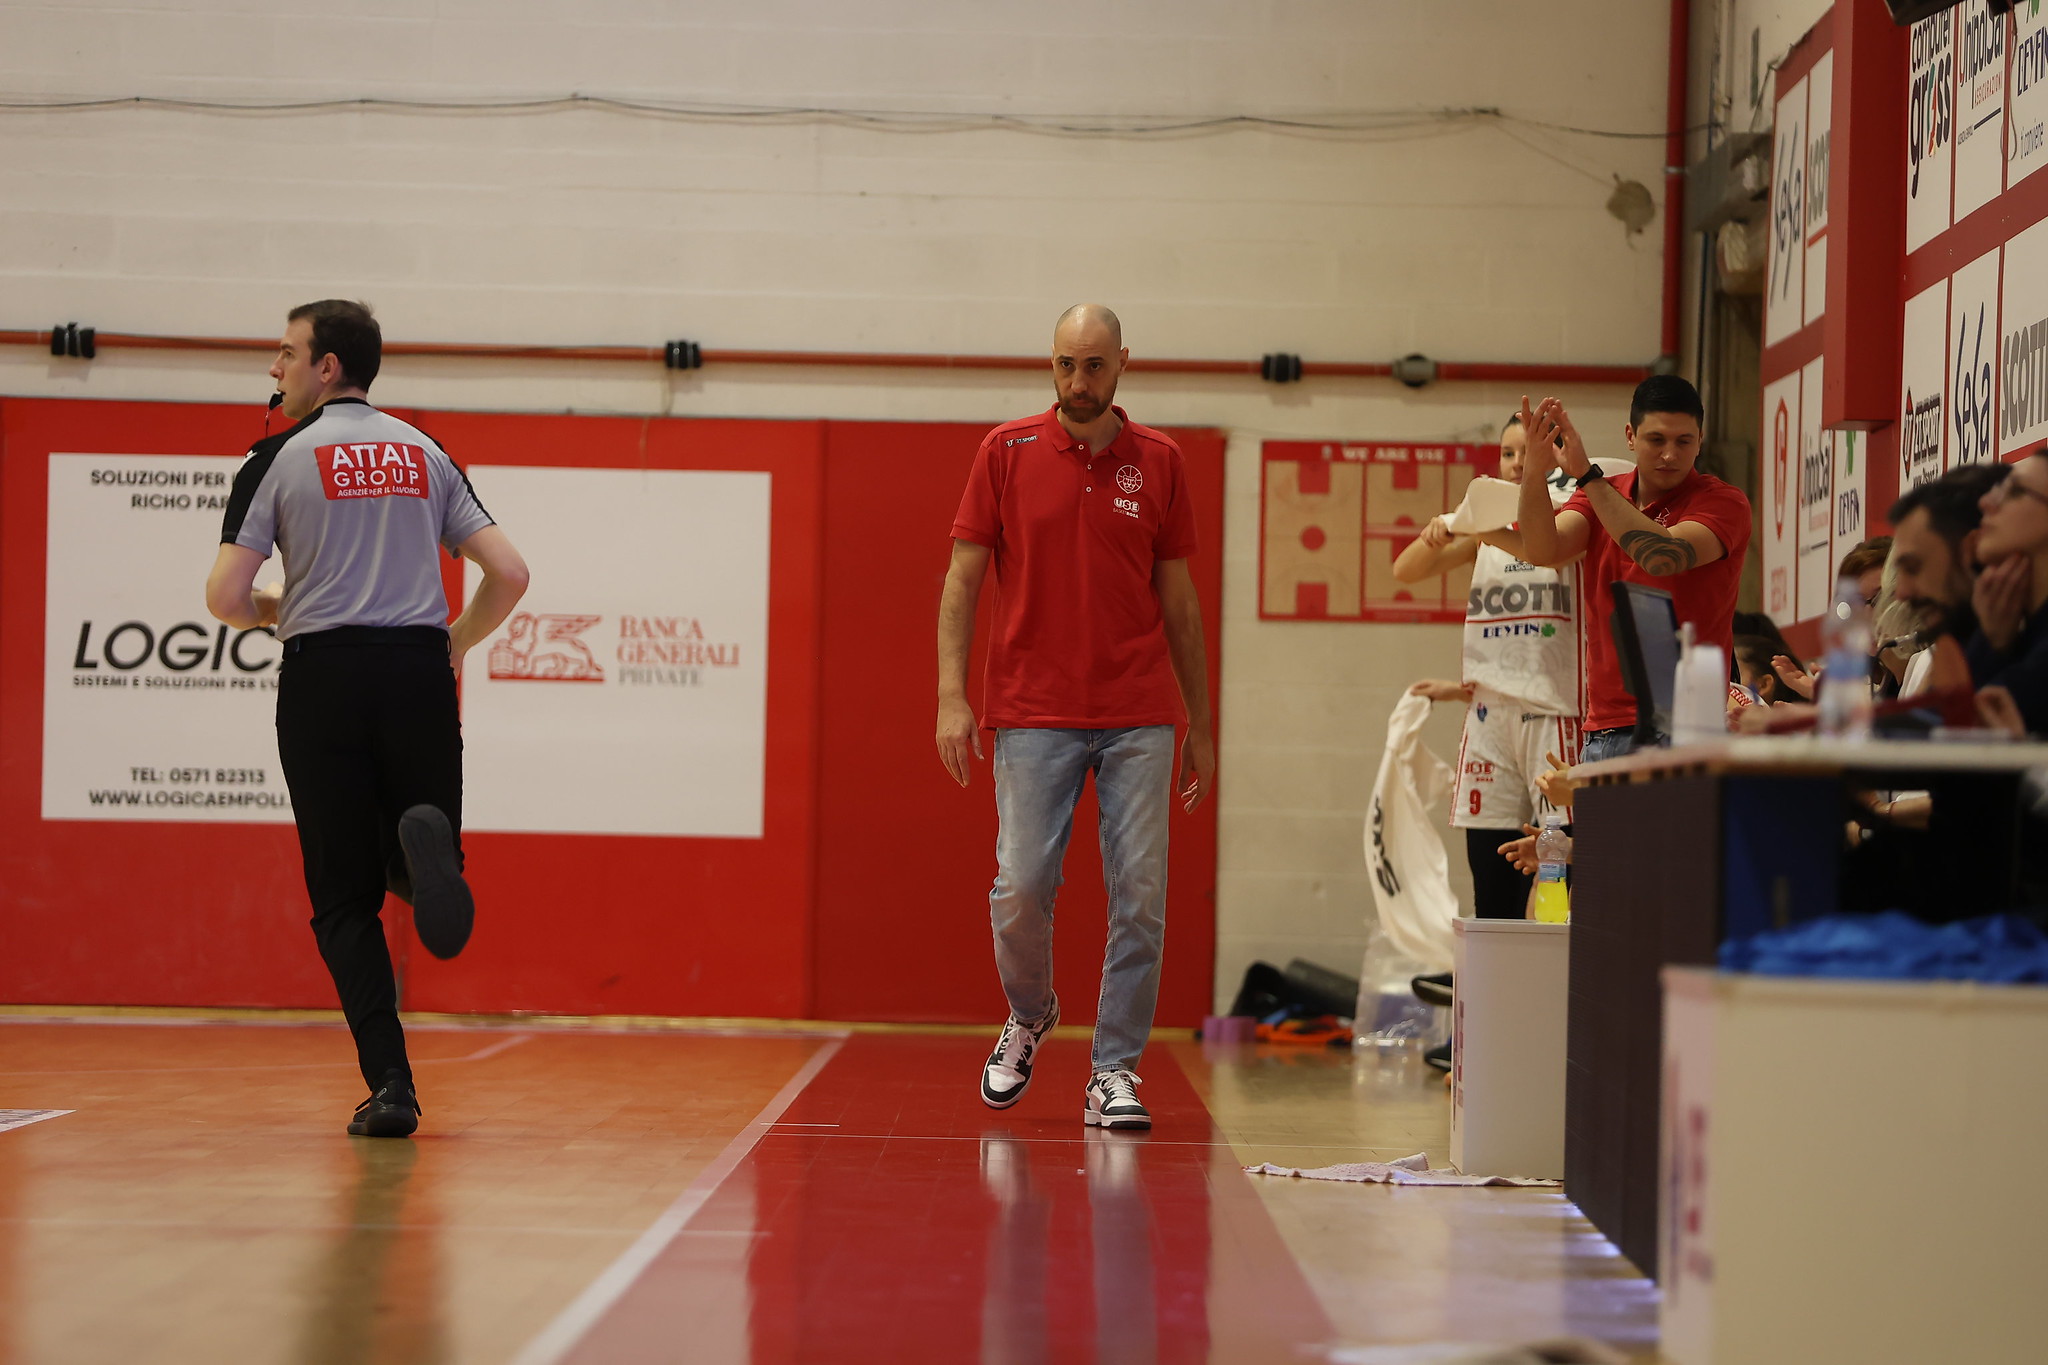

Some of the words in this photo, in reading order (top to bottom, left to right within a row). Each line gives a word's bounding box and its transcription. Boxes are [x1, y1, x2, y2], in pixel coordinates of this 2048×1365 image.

[332, 443, 418, 470] ATTAL
[91, 470, 187, 486] SOLUZIONI
[193, 472, 226, 486] PER
[333, 468, 419, 487] GROUP
[131, 493, 191, 509] RICHO
[337, 488, 368, 497] AGENZIE
[368, 487, 383, 495] PER
[1467, 583, 1571, 616] SCOTTI
[620, 615, 705, 639] BANCA
[73, 621, 283, 672] LOGIC
[617, 641, 740, 667] GENERALI
[74, 675, 127, 687] SISTEMI
[132, 676, 139, 687] E
[145, 677, 225, 688] SOLUZIONI
[231, 678, 255, 688] PER
[131, 767, 164, 783] TEL:
[170, 768, 209, 783] 0571
[1469, 788, 1481, 815] 9
